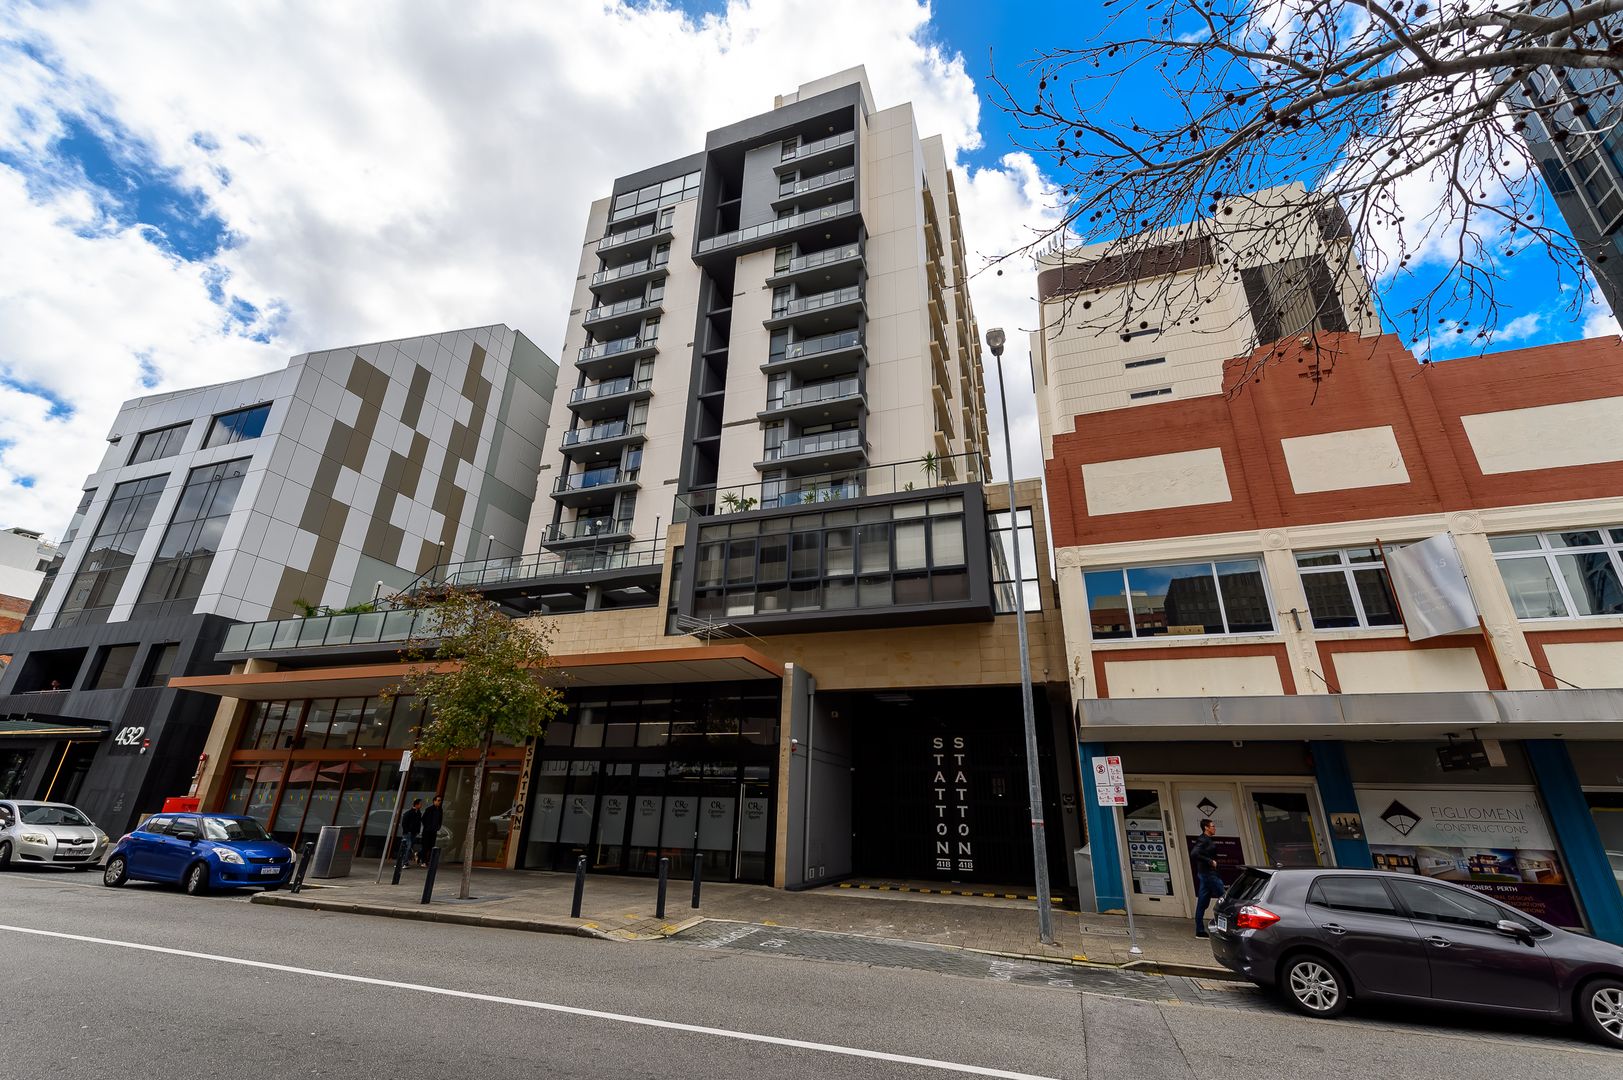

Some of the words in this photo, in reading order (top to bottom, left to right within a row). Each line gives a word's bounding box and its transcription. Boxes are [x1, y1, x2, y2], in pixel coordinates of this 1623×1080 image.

[115, 726, 145, 746] 432
[514, 747, 533, 825] STATTON
[933, 737, 950, 854] STATTON
[953, 737, 971, 855] STATTON
[1430, 806, 1525, 820] FIGLIOMENI
[1335, 817, 1358, 827] 414
[1435, 823, 1529, 834] CONSTRUCTIONS
[936, 860, 951, 868] 418
[958, 861, 973, 869] 418
[1496, 885, 1519, 893] PERTH
